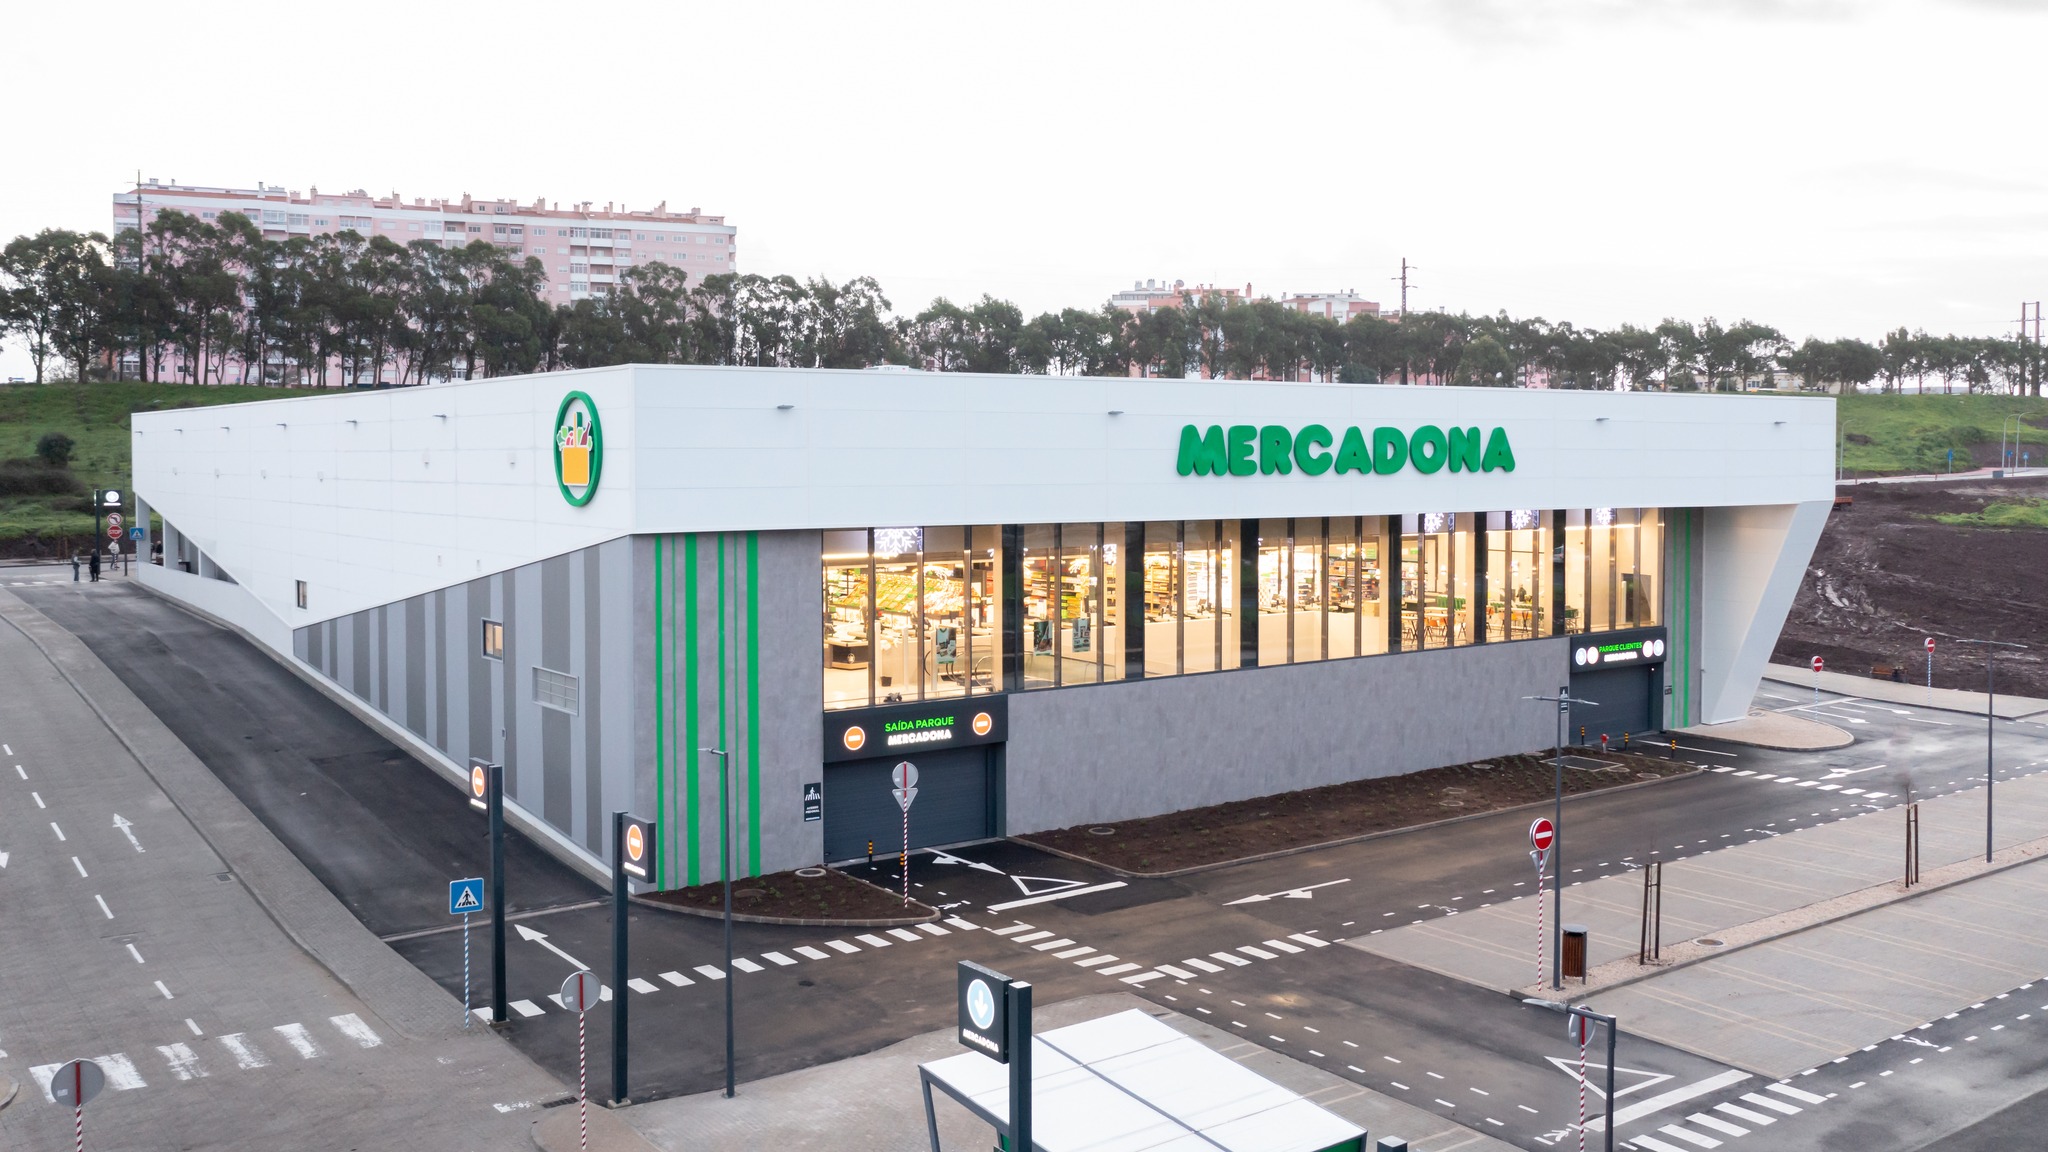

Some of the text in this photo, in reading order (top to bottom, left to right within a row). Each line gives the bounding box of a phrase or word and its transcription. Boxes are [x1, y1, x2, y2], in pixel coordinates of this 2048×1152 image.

[1176, 424, 1516, 476] MERCADONA
[1599, 641, 1642, 652] PARQUE CLIENTES
[885, 716, 954, 732] SAÍDA PARQUE
[887, 729, 952, 746] MERCADONA
